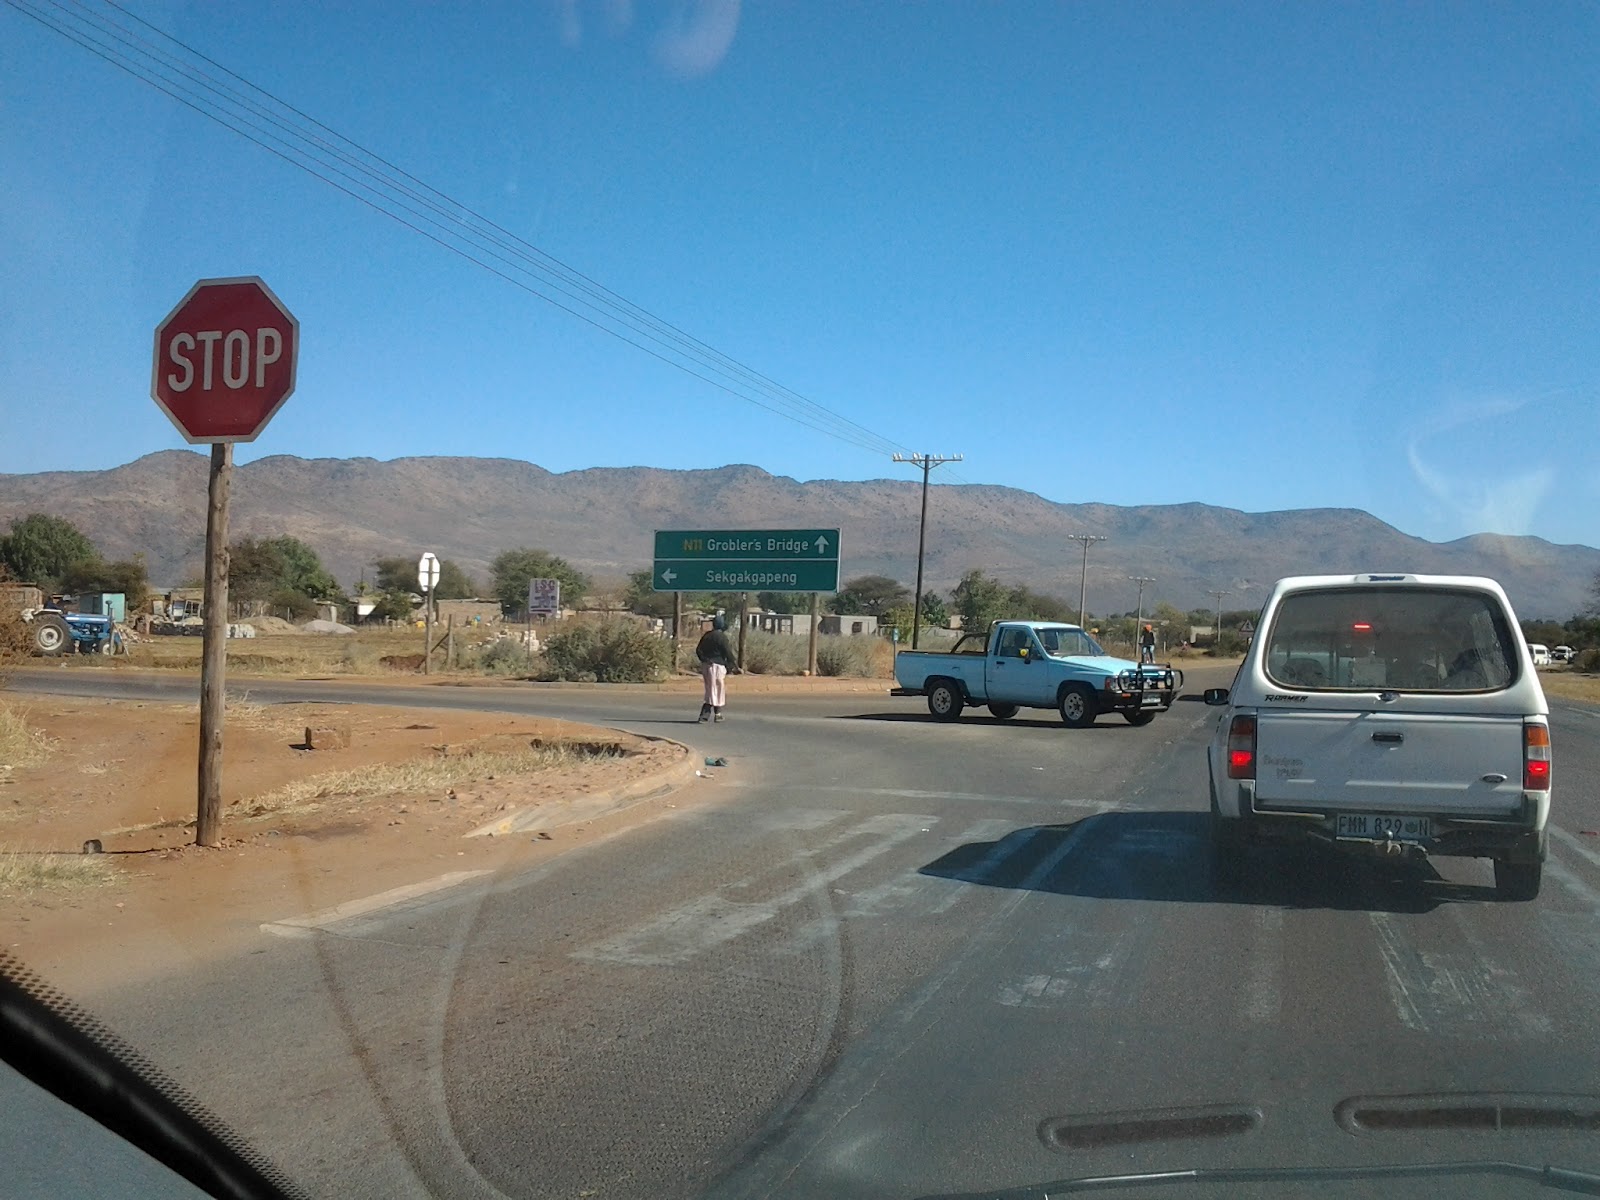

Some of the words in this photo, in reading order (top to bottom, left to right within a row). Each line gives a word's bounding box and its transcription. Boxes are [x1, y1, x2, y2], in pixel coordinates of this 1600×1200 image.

[168, 327, 282, 392] STOP
[707, 538, 762, 551] Grobler's
[767, 538, 809, 553] Bridge
[706, 570, 797, 585] Sekgakgapeng
[1419, 819, 1429, 836] N
